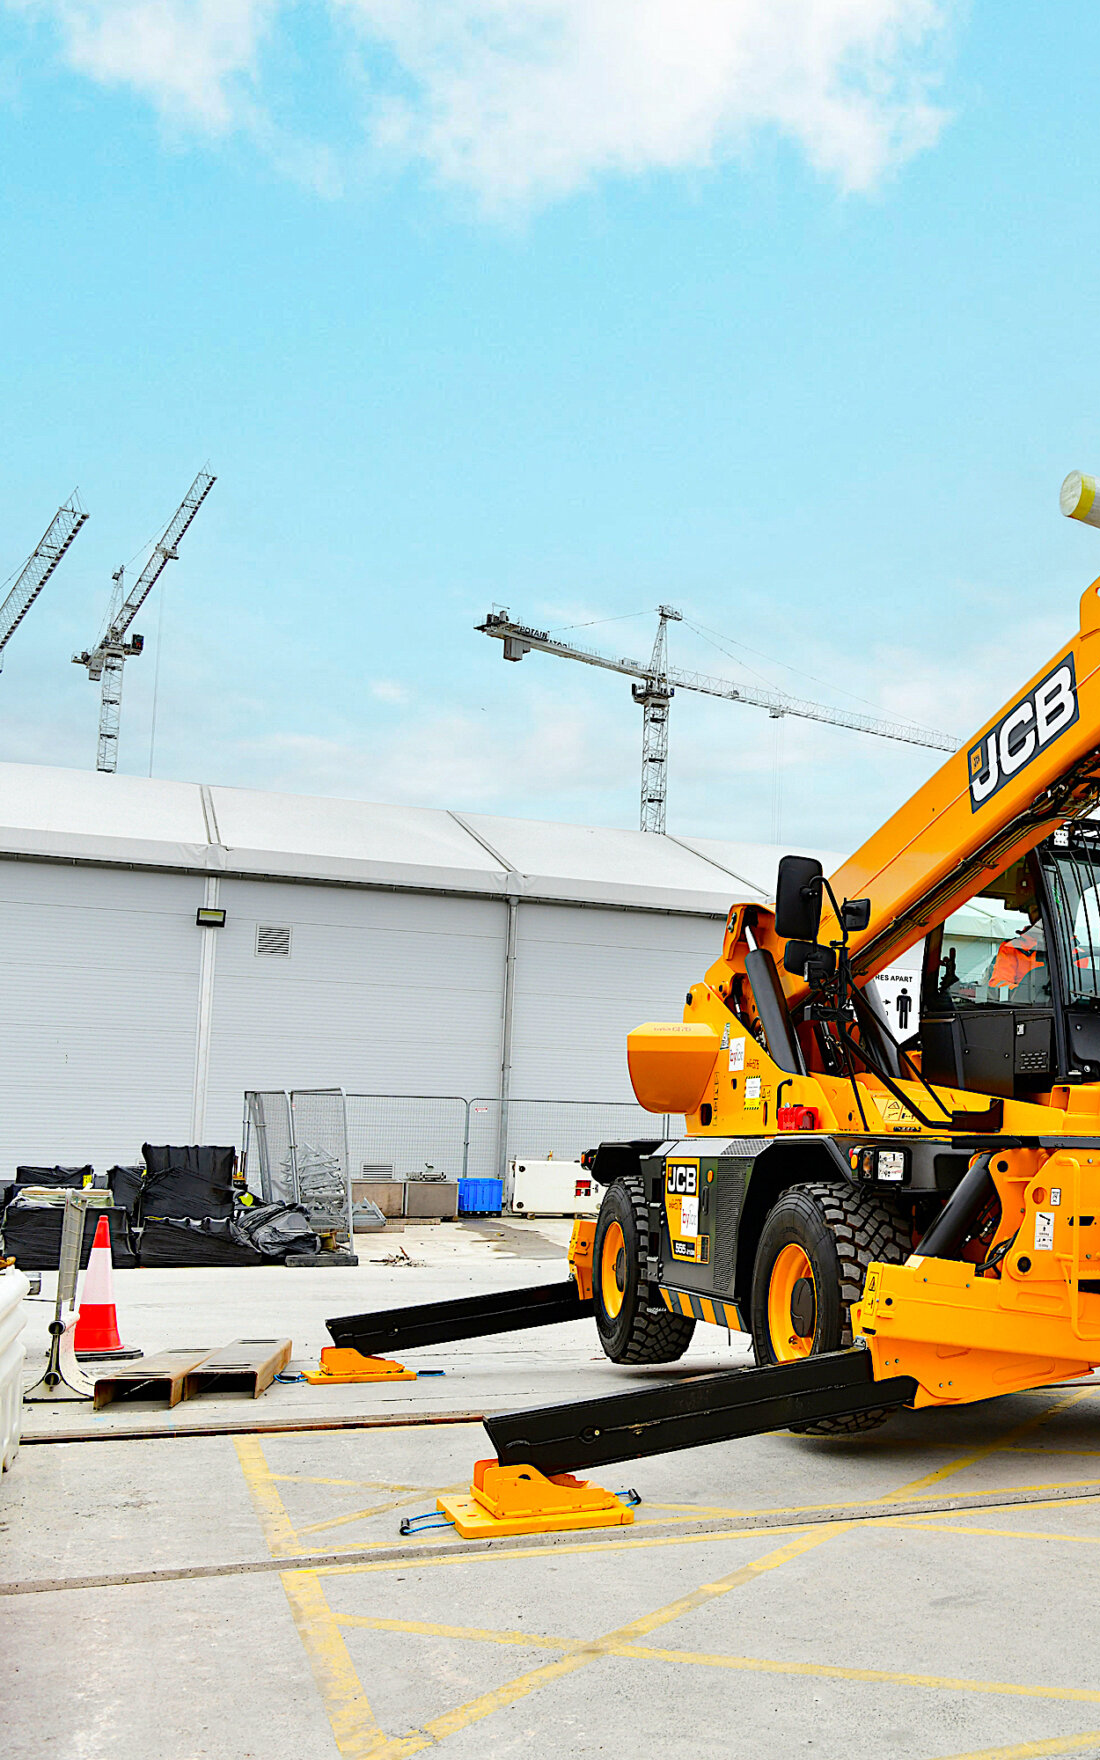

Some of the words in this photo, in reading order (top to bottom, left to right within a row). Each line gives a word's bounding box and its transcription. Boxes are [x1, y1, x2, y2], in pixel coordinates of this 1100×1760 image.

[520, 625, 549, 640] POTAIN
[971, 666, 1075, 802] JCB
[890, 975, 913, 983] APART
[668, 1166, 697, 1193] JCB
[682, 1208, 697, 1229] bylor
